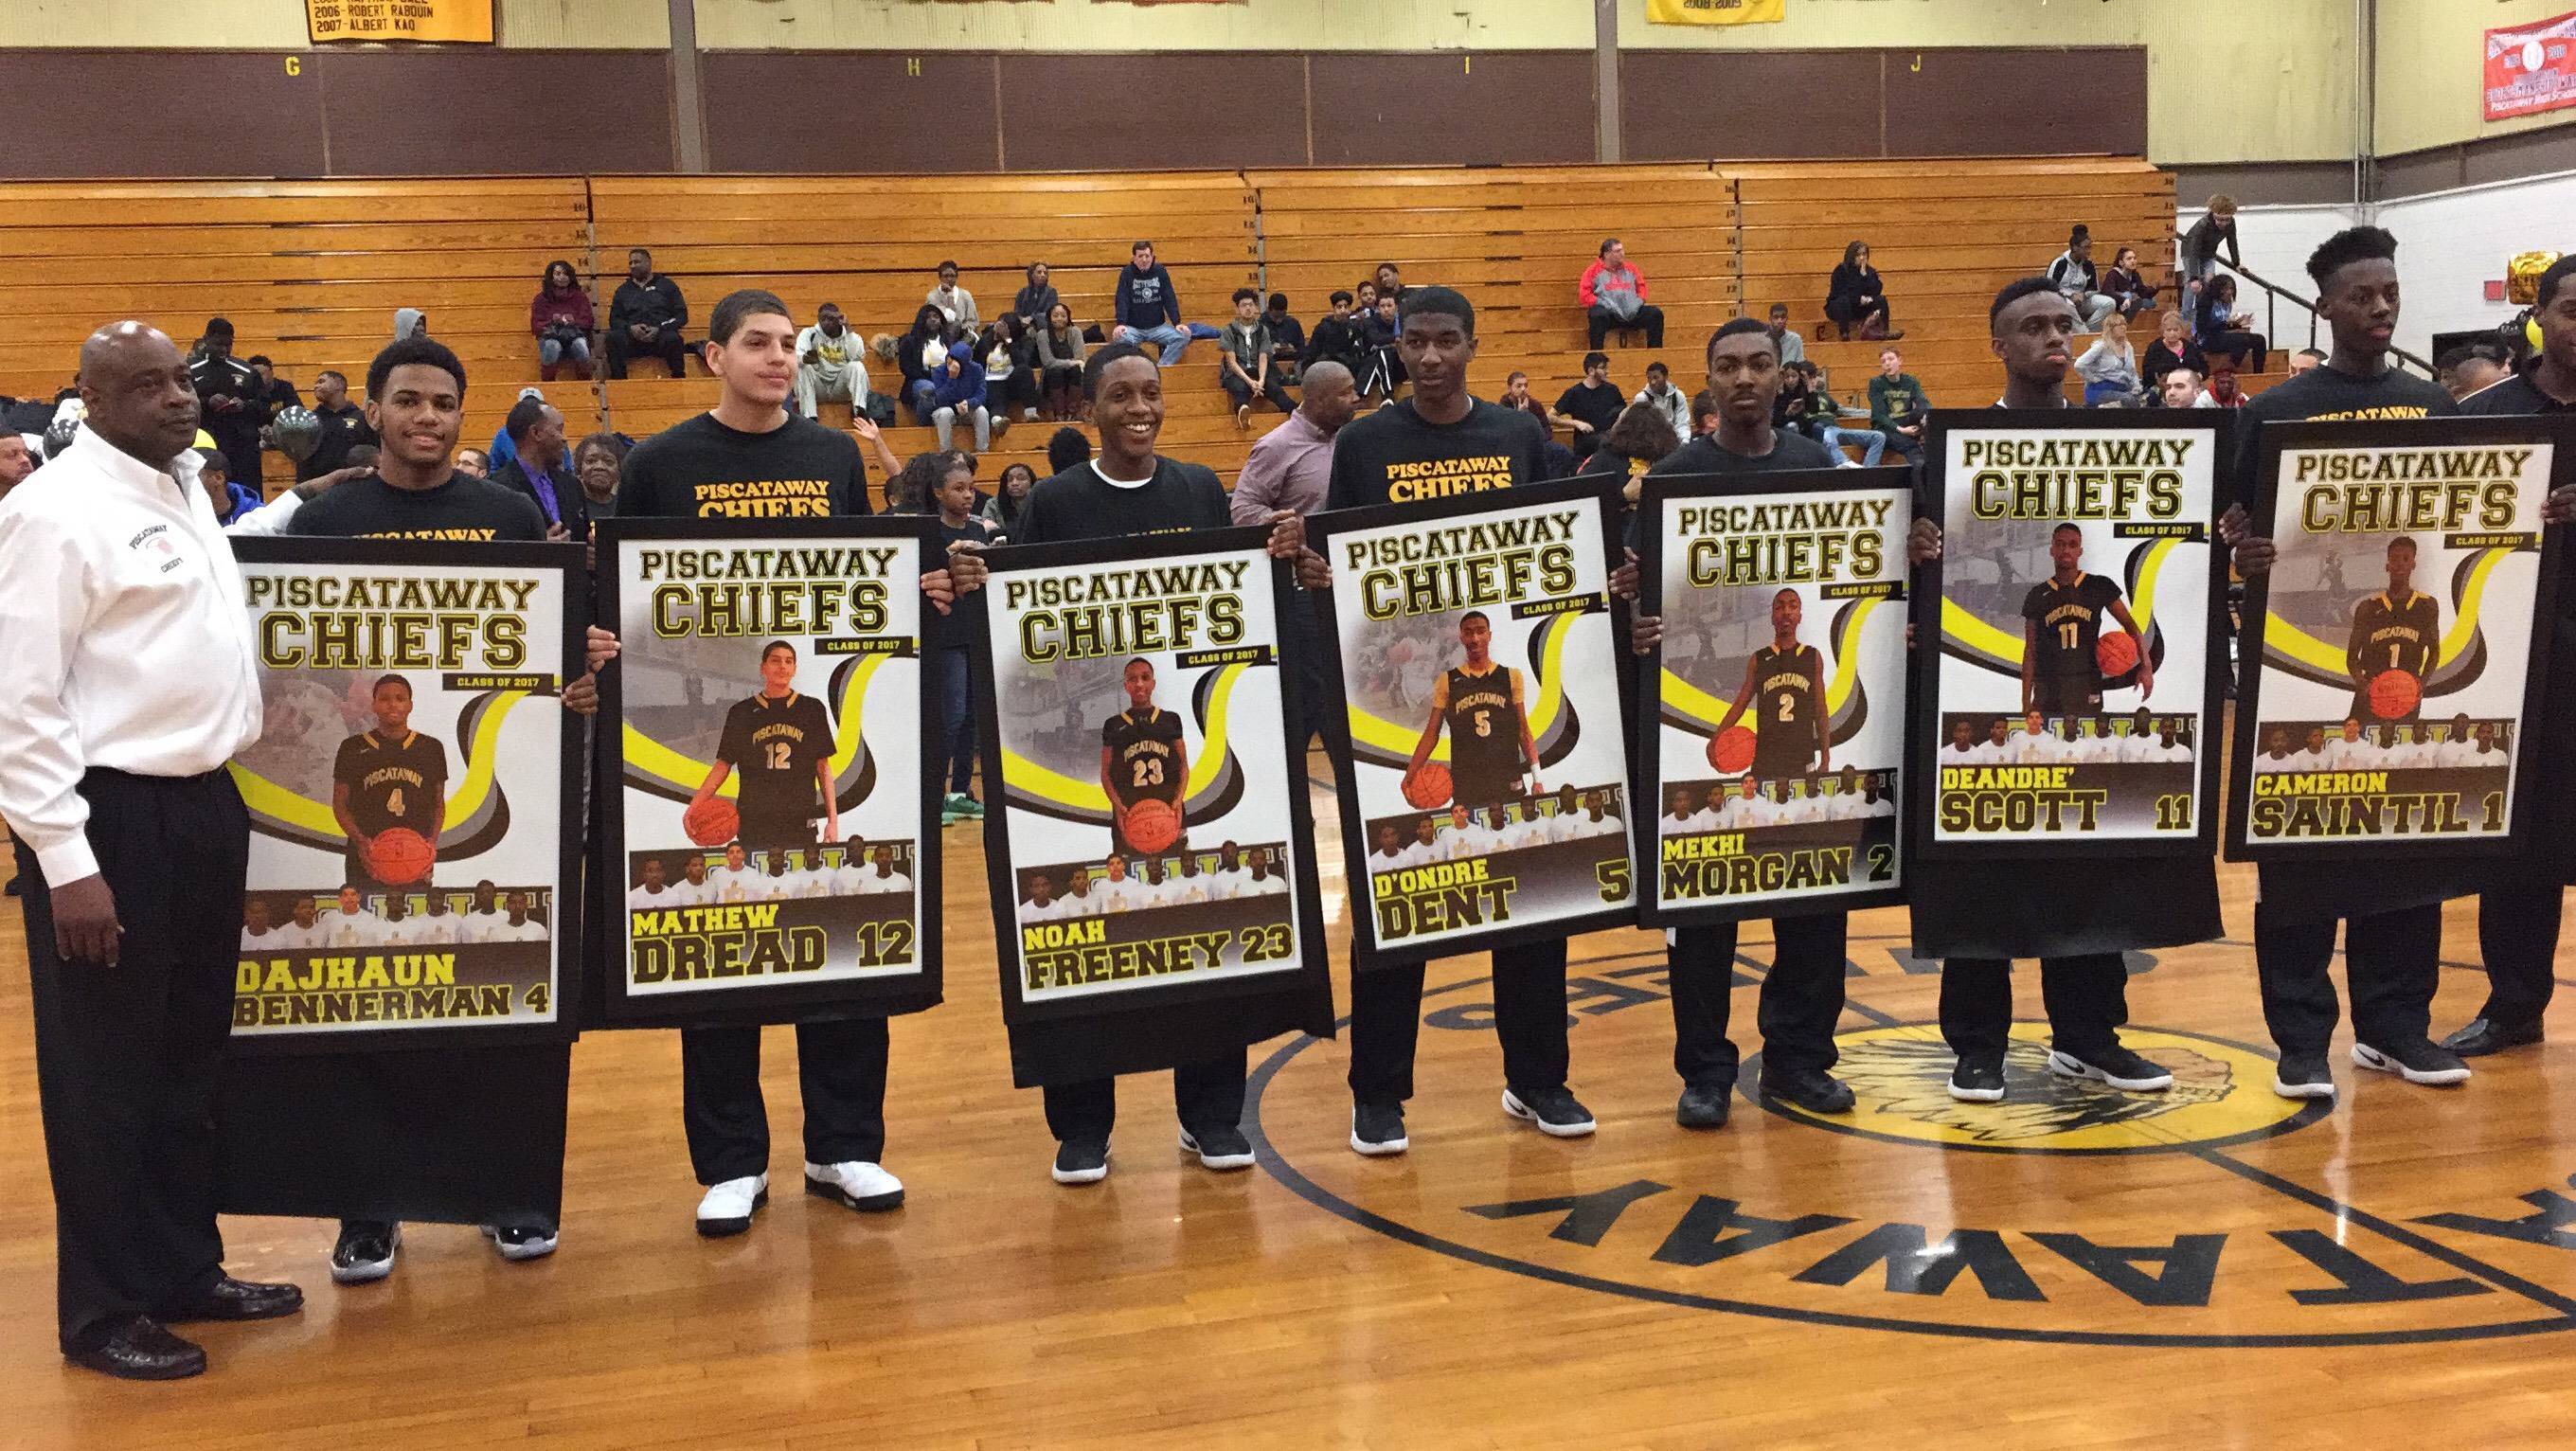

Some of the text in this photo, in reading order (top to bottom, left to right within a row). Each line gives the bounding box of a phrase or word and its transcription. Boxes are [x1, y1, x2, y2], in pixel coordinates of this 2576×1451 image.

[285, 56, 300, 77] G
[907, 58, 921, 77] H
[1910, 55, 1922, 73] J
[1386, 457, 1511, 479] PISCATAWAY
[1962, 439, 2194, 468] PISCATAWAY
[2296, 450, 2533, 483] PISCATAWAY
[694, 480, 830, 501] PISCATAWAY
[1389, 473, 1512, 504] CHIEFS
[1971, 469, 2183, 521] CHIEFS
[1678, 498, 1894, 536] PISCATAWAY
[2301, 479, 2518, 533] CHIEFS
[1346, 510, 1580, 570] PISCATAWAY
[2125, 526, 2192, 535] CLASS OF 2017
[2456, 535, 2524, 546] CLASS OF 2017
[639, 546, 899, 581] PISCATAWAY
[1687, 529, 1883, 588] CHIEFS
[245, 575, 539, 611] PISCATAWAY
[1005, 560, 1250, 610] PISCATAWAY
[1360, 543, 1577, 622] CHIEFS
[1831, 583, 1892, 597] CLASS OF 2017
[651, 580, 888, 638] CHIEFS
[1523, 598, 1591, 615] CLASS OF 2017
[259, 611, 527, 671] CHIEFS
[1018, 592, 1245, 663] CHIEFS
[2059, 622, 2078, 650] 11
[827, 640, 901, 652] CLASS OF 2017
[1188, 650, 1259, 664] CLASS OF 2017
[2389, 643, 2401, 668] 1
[457, 677, 539, 688] CLASS OF 2017
[1779, 693, 1795, 722] 2
[1475, 710, 1491, 737] 5
[765, 743, 792, 769] 12
[1133, 758, 1164, 786] 23
[1941, 766, 2075, 790] DEANDRE'
[2255, 772, 2388, 796] CAMERON
[386, 788, 405, 816] 4
[1941, 788, 2107, 833] SCOTT
[2155, 794, 2191, 831] 11
[2252, 790, 2505, 838] SAINTIL 1
[1662, 833, 1745, 861] MEKHI
[1373, 858, 1489, 898] D'ONDRE
[1662, 843, 1895, 901] MORGAN 2
[1376, 858, 1631, 941] DENT 5
[633, 904, 779, 936] MATHEW
[633, 920, 914, 984] DREAD 12
[1025, 921, 1106, 952] NOAH
[1024, 923, 1295, 991] FREENEY 23
[236, 954, 455, 993] DAJHAUN
[233, 983, 549, 1027] BENNERMAN 4
